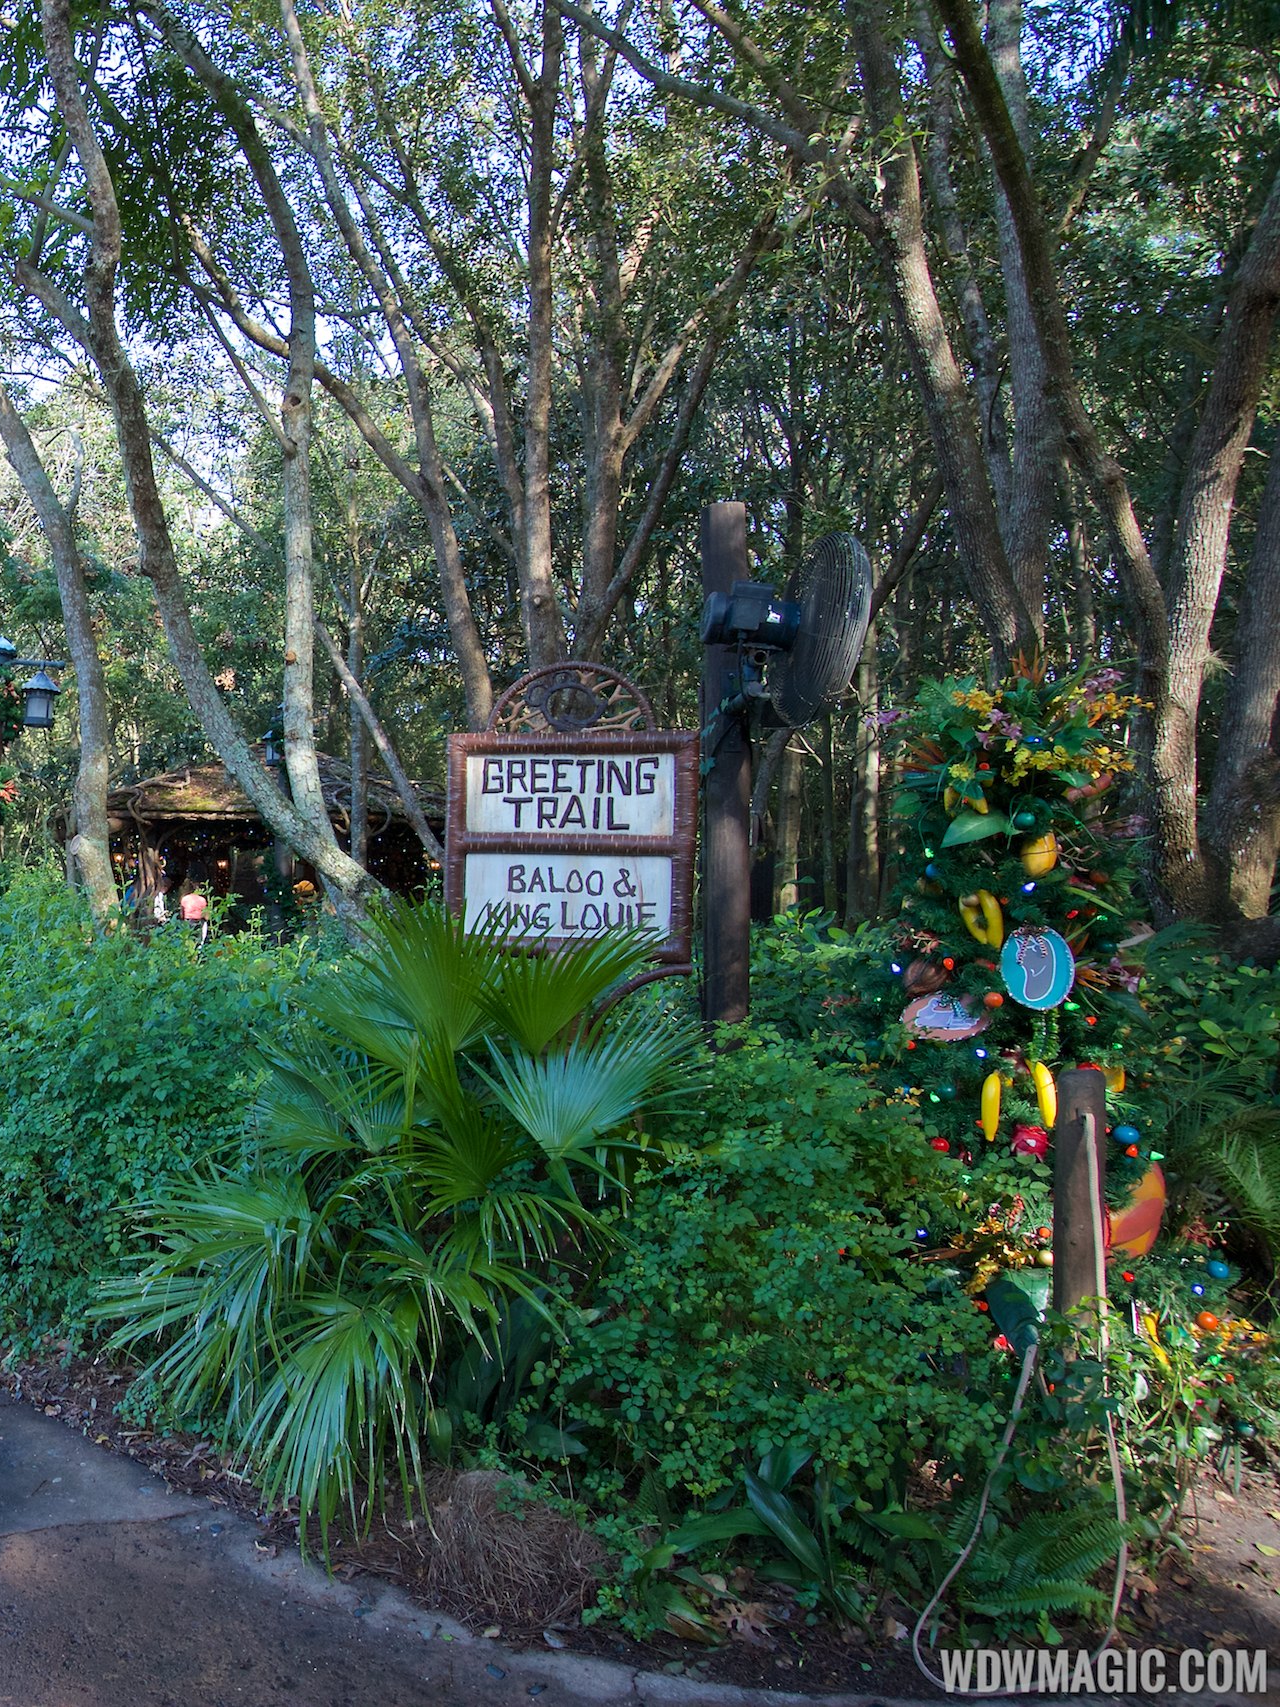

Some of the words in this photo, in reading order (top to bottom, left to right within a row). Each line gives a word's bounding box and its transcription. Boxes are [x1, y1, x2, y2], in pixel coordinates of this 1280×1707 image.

[482, 757, 659, 795] GREETING
[503, 795, 630, 830] TRAIL
[507, 865, 604, 896] BALOO
[612, 868, 637, 898] &
[561, 902, 660, 932] LOUIE
